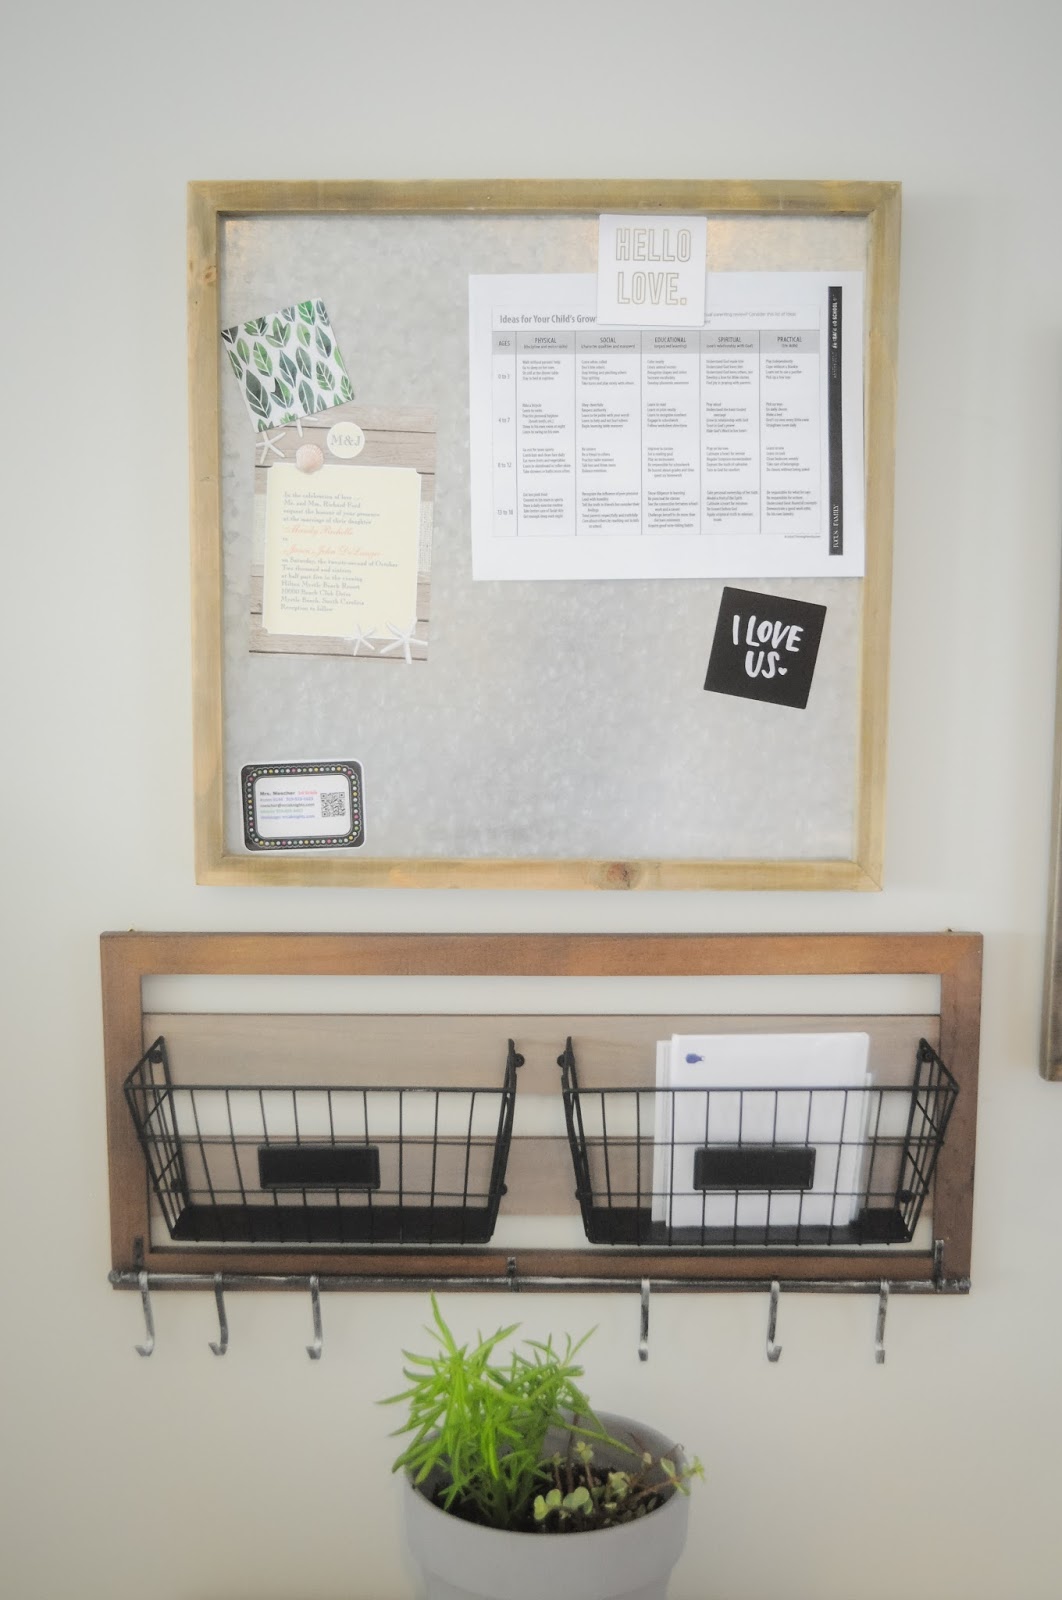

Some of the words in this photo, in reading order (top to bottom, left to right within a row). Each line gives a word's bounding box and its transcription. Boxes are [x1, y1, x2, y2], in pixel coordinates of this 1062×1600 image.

[616, 228, 691, 262] HELLO
[617, 271, 687, 305] LOVE.
[500, 315, 519, 324] Ideas
[521, 315, 532, 324] for
[533, 315, 550, 324] Your
[551, 314, 575, 324] Child's
[576, 314, 597, 324] Grow
[331, 434, 361, 446] M&J
[732, 614, 740, 646] I
[746, 615, 804, 652] LOVE
